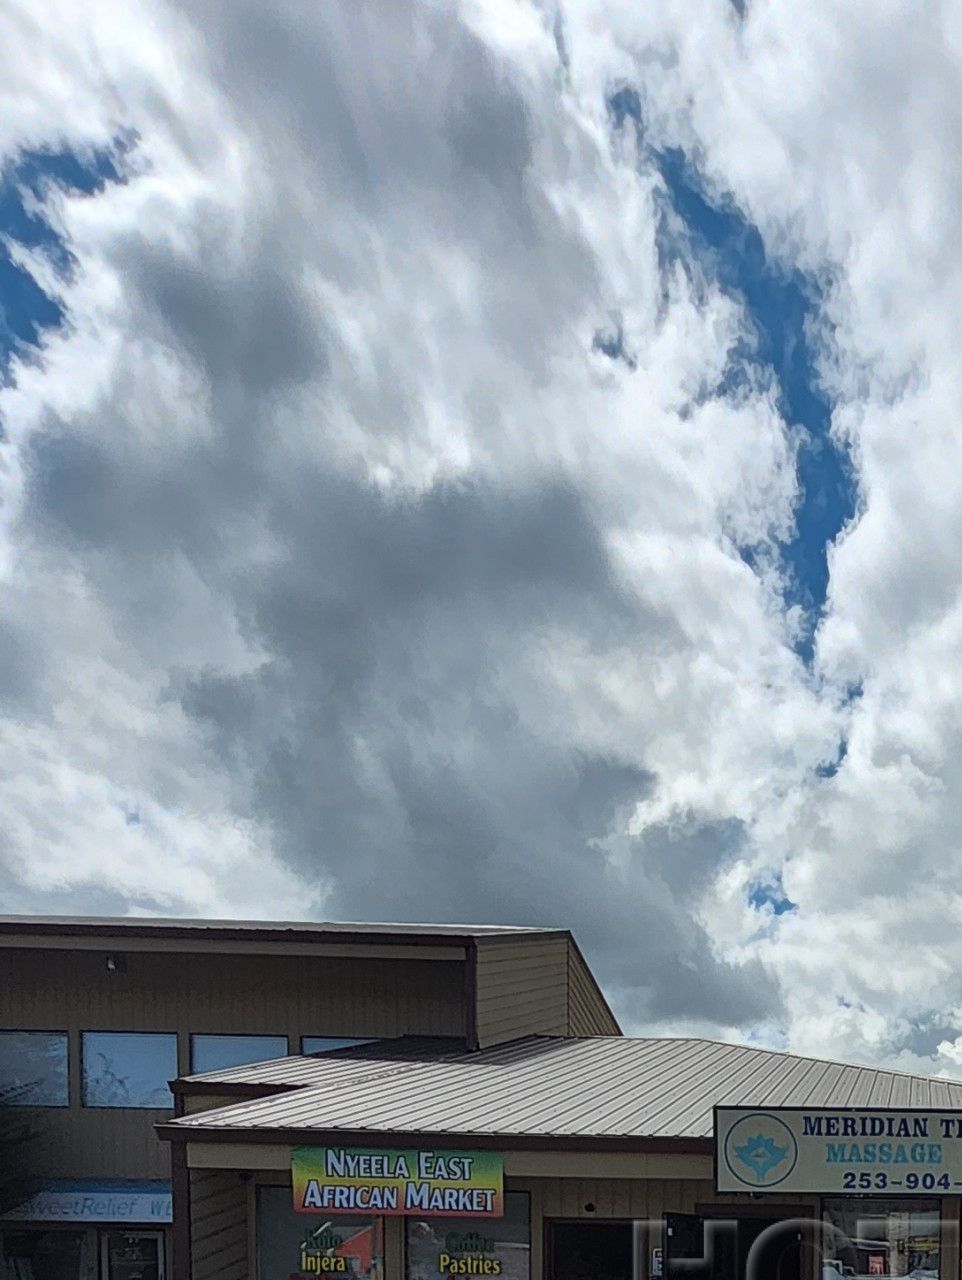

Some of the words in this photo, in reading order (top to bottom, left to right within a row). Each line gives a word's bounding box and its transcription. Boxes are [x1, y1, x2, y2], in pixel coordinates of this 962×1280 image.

[802, 1115, 928, 1137] MERIDIAN
[326, 1149, 411, 1179] NYEELA
[418, 1150, 474, 1181] EAST
[826, 1143, 942, 1164] MASSAGE
[303, 1179, 398, 1209] AFRICAN
[405, 1181, 496, 1212] MARKET
[301, 1250, 347, 1276] Injera
[439, 1253, 501, 1275] Pastries
